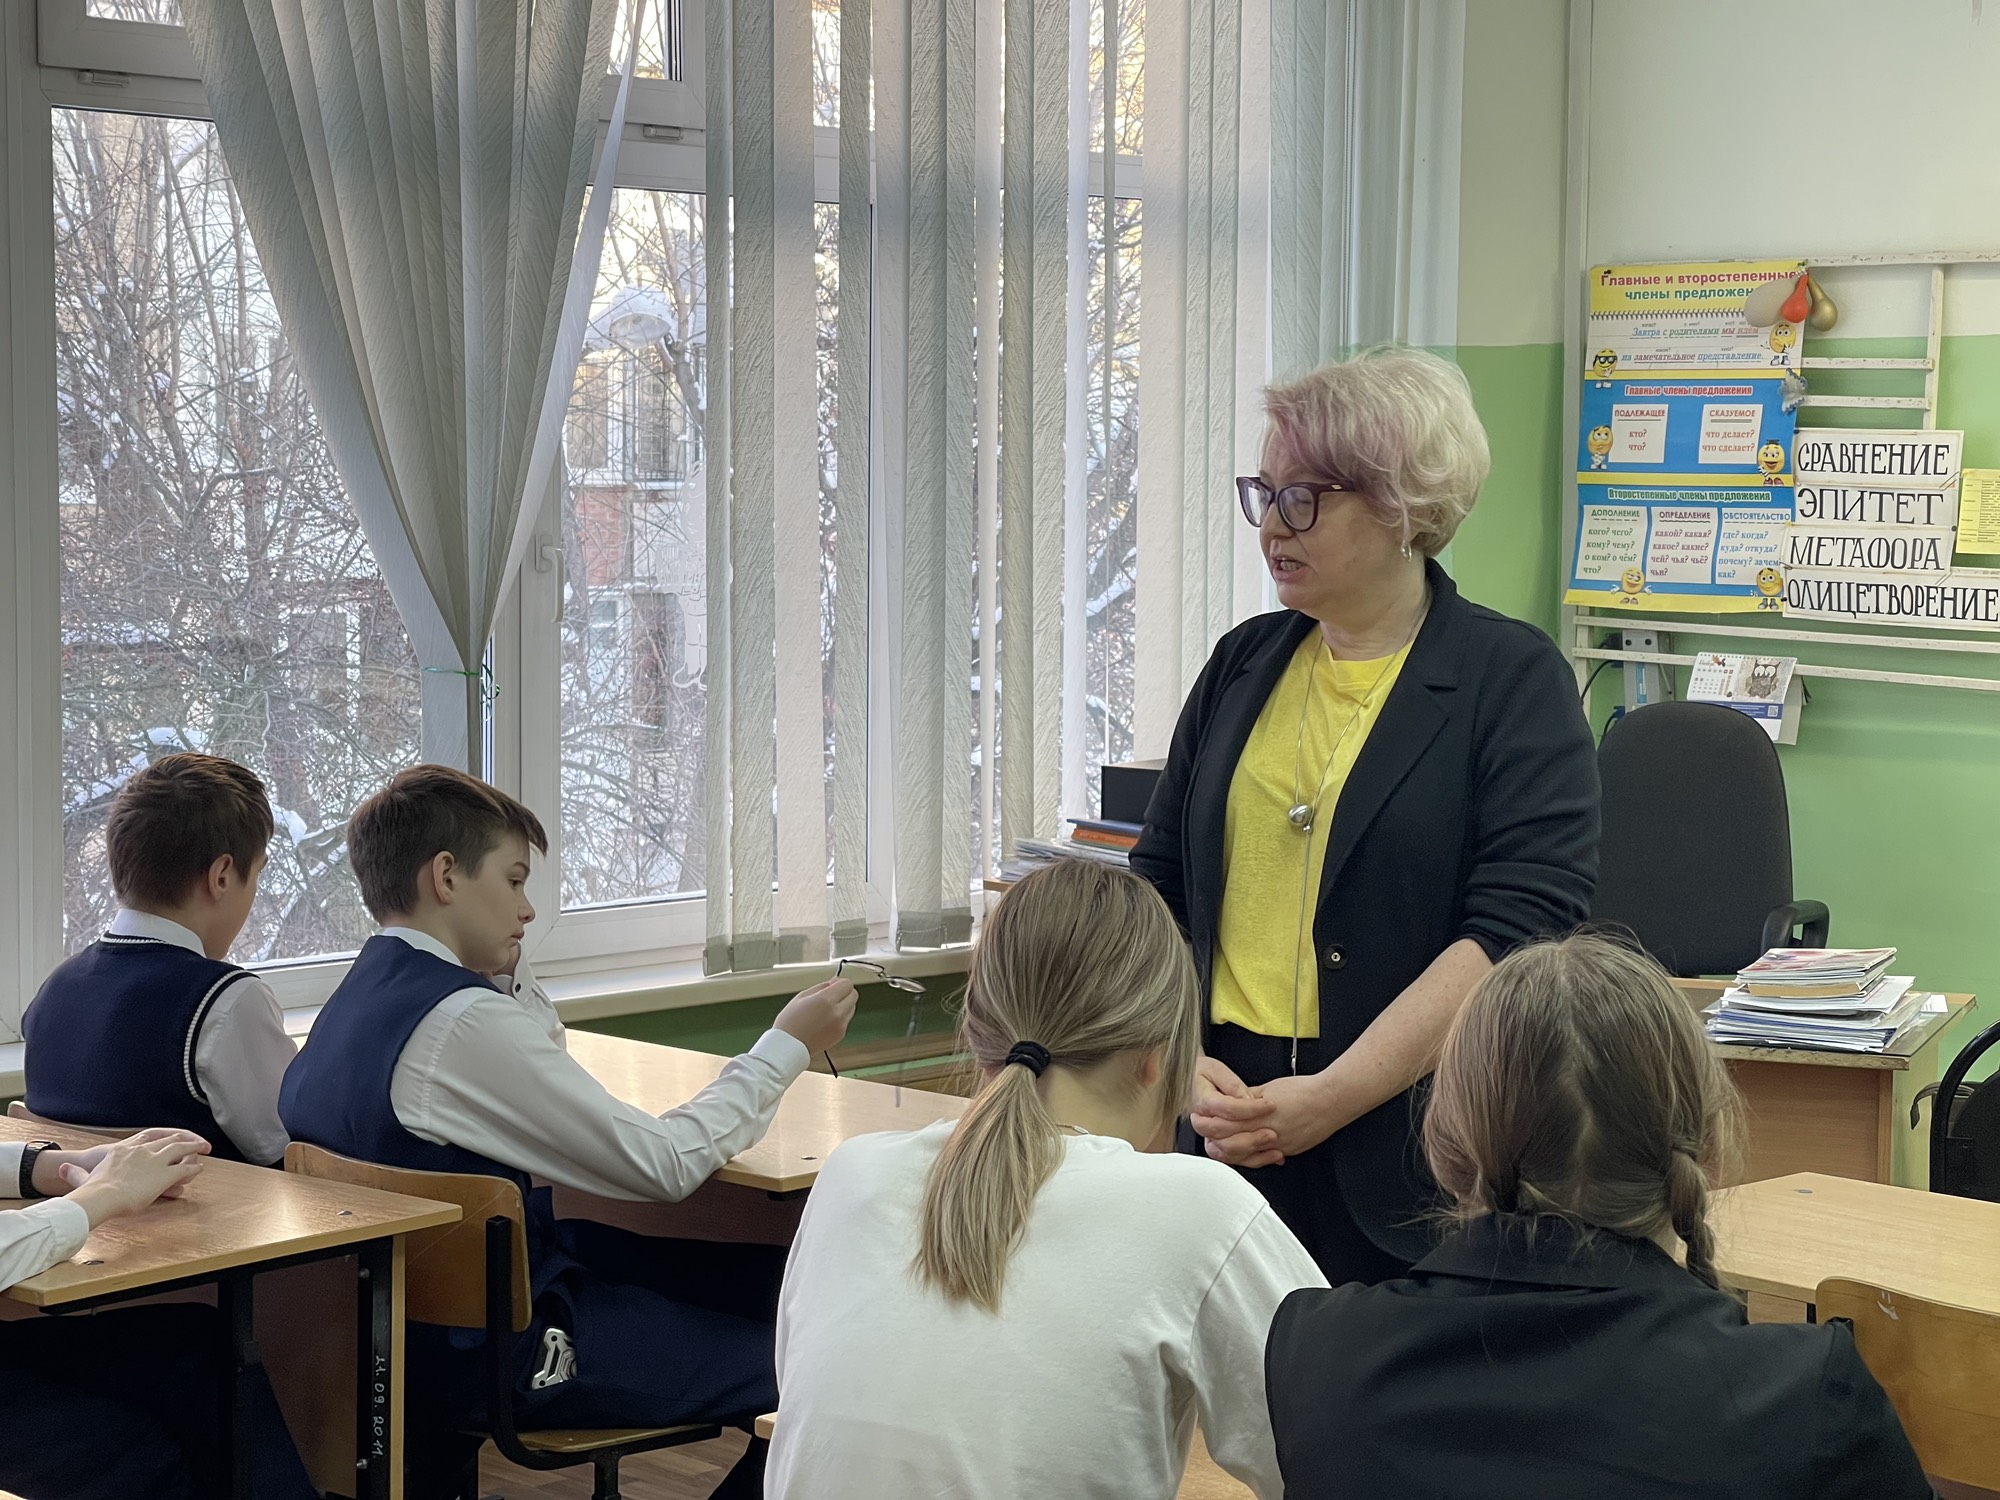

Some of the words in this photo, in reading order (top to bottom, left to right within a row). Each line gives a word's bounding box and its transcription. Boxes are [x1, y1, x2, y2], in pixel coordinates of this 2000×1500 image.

[1600, 273, 1661, 287] Главные
[1665, 275, 1674, 285] и
[1625, 290, 1670, 301] члены
[1632, 327, 1661, 337] Завтра
[1668, 327, 1719, 338] родителями
[1721, 327, 1735, 335] мы
[1633, 353, 1696, 361] замечательное
[1625, 385, 1661, 396] Главные
[1663, 386, 1691, 395] члены
[1692, 386, 1752, 397] предложения
[1614, 409, 1666, 418] ПОДЛЕЖАЩЕЕ
[1709, 409, 1756, 417] СКАЗУЕМОЕ
[1629, 429, 1647, 438] кто?
[1721, 429, 1755, 439] делает?
[1628, 442, 1647, 451] что?
[1702, 444, 1717, 452] что
[1718, 442, 1756, 453] сделает?
[1798, 442, 1950, 476] СРАВНЕНИЕ
[1608, 488, 1677, 500] Второстепенные
[1679, 491, 1707, 500] члены
[1709, 491, 1771, 502] предложения
[1798, 487, 1944, 526] ЭПИТЕТ
[1591, 509, 1640, 518] ДОПОЛНЕНИЕ
[1659, 511, 1711, 520] ОПРЕДЕЛЕНИЕ
[1723, 512, 1791, 521] ОБСТОЯТЕЛЬСТВО
[1588, 527, 1611, 536] кого?
[1655, 529, 1683, 538] какой?
[1684, 529, 1712, 538] какая?
[1722, 530, 1740, 539] где?
[1741, 530, 1769, 540] когда?
[1586, 540, 1611, 551] кому?
[1720, 543, 1744, 554] куда?
[1744, 544, 1778, 555] откуда?
[1591, 553, 1611, 561] ком?
[1790, 535, 1945, 571] МЕТАФОРА
[1718, 556, 1753, 568] почему?
[1583, 565, 1602, 574] что?
[1717, 569, 1736, 578] как?
[1787, 578, 1999, 622] ОЛИЦЕТВОРЕНИЕ
